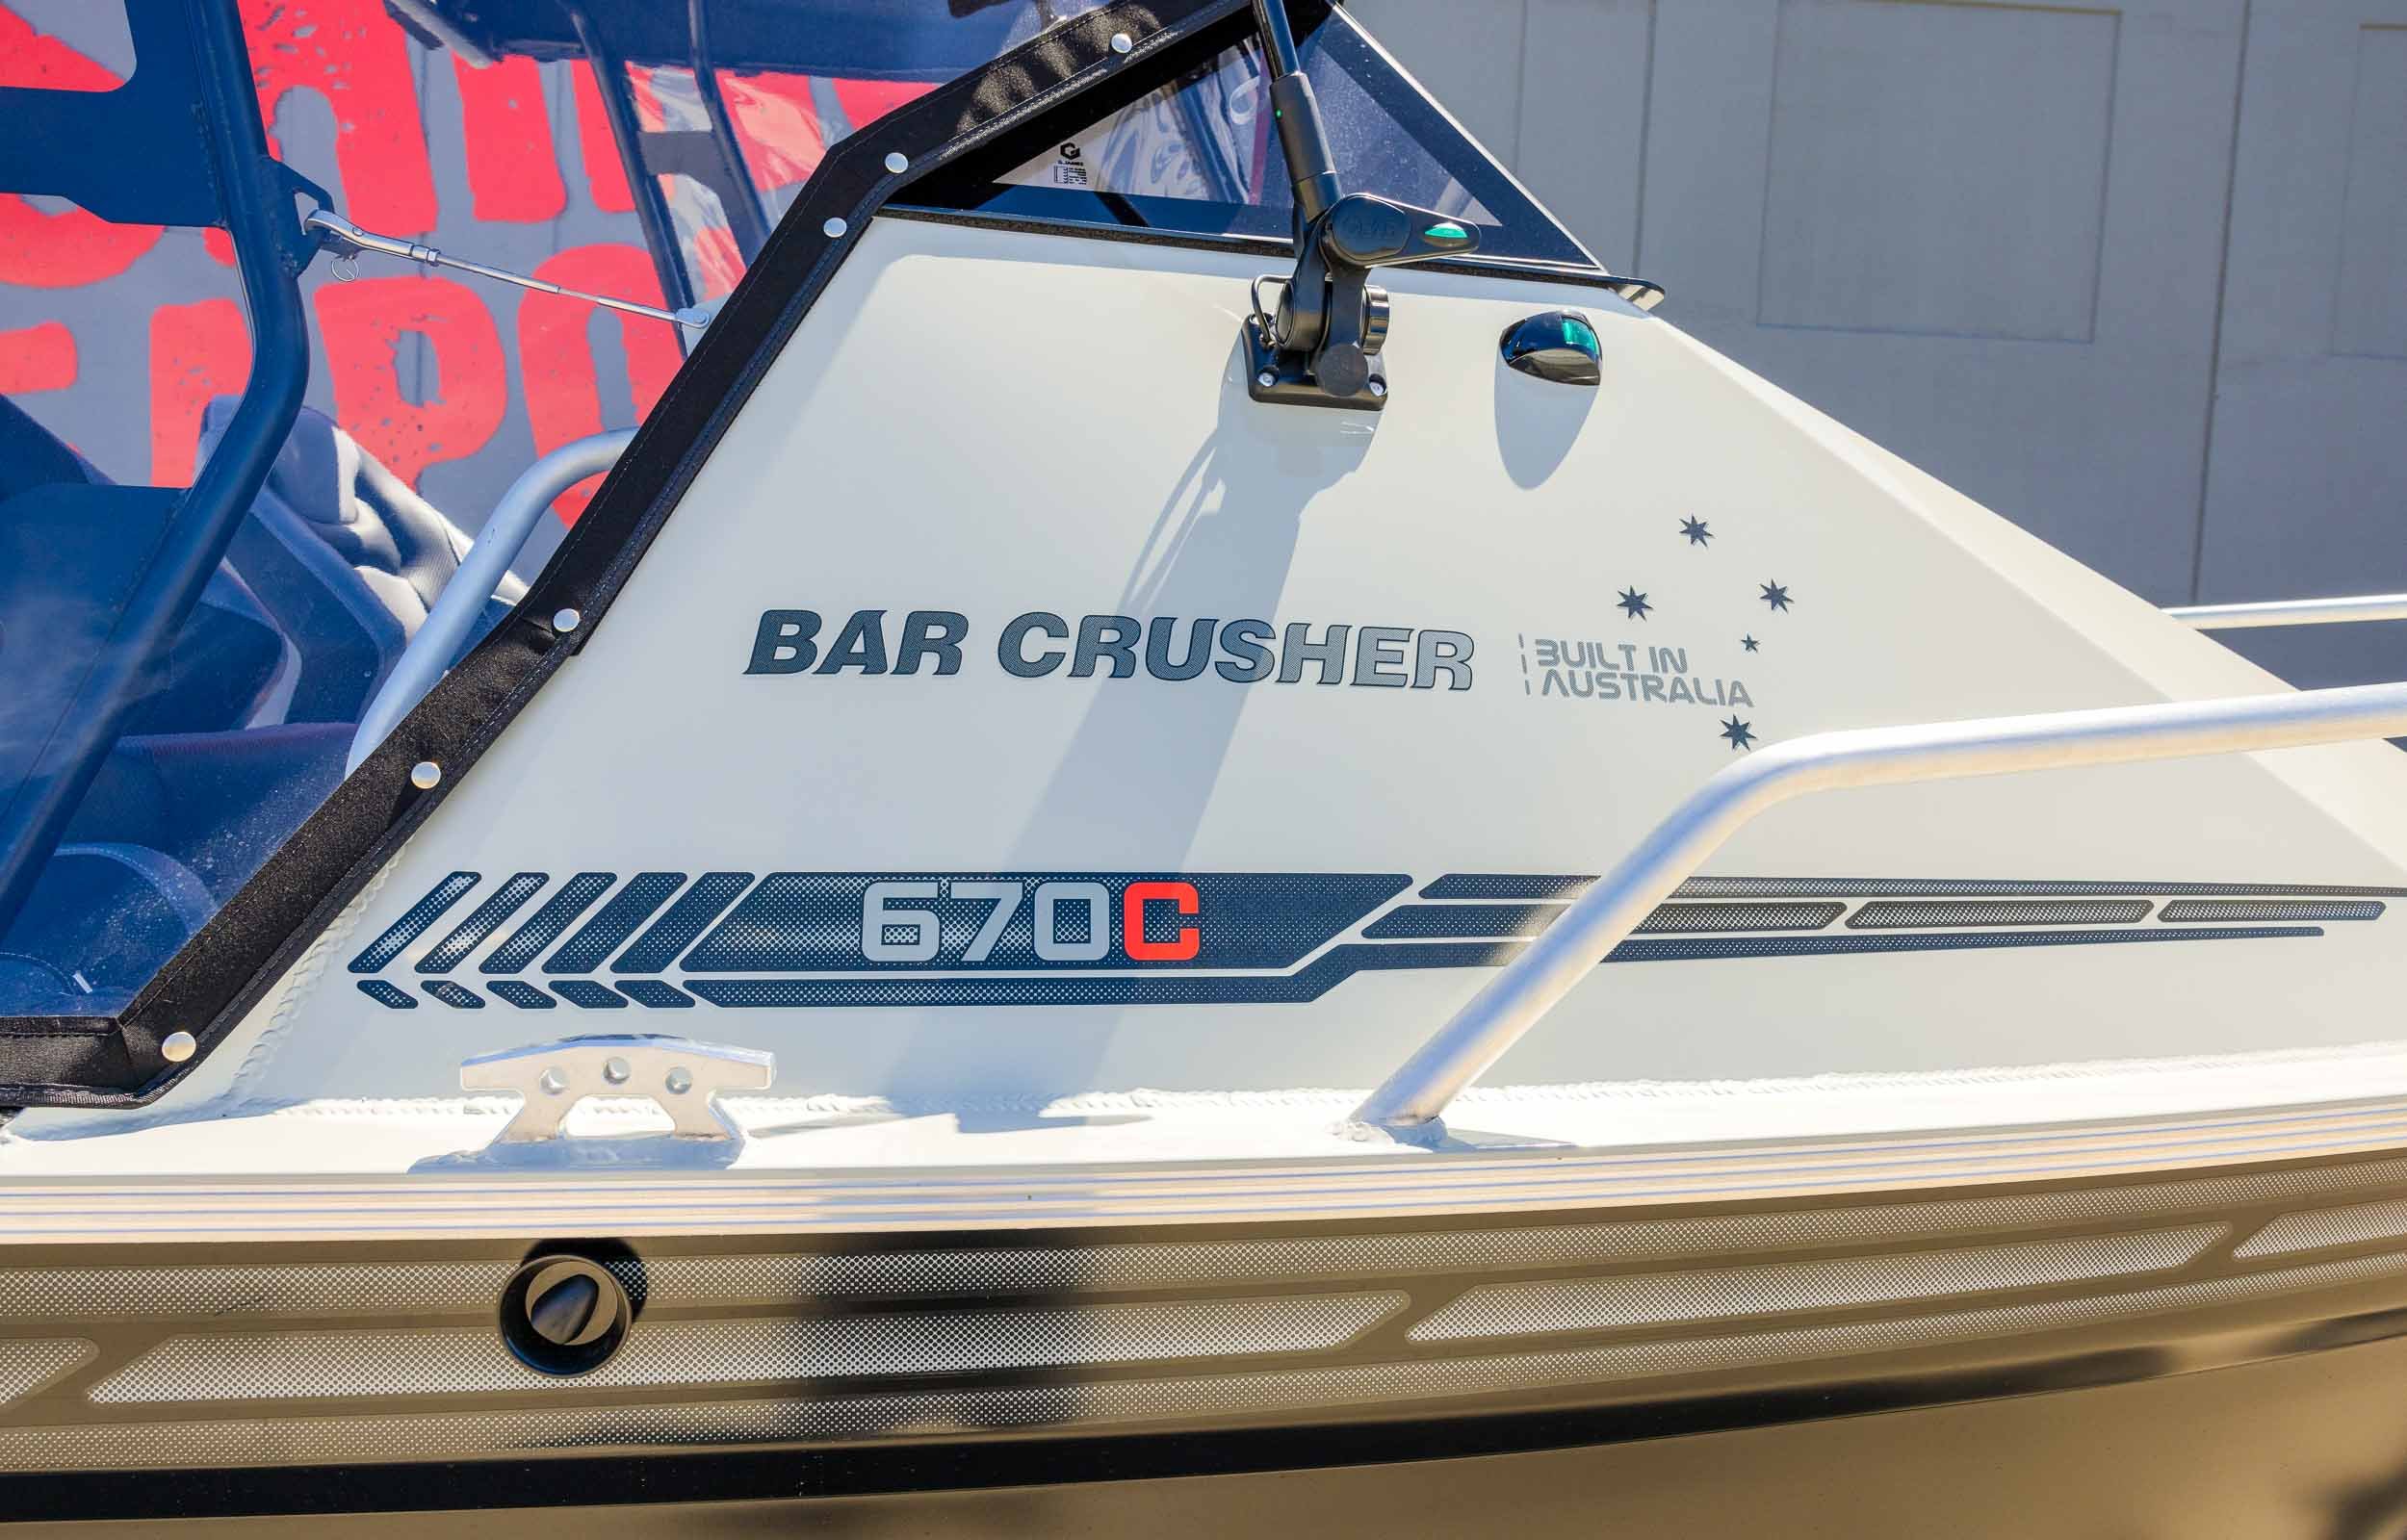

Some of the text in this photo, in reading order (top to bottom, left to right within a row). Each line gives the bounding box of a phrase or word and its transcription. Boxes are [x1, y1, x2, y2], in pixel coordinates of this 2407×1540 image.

[742, 609, 1474, 691] BAR CRUSHER
[1535, 638, 1688, 674] BUILT IN
[1541, 668, 1754, 707] AUSTRALIA
[862, 881, 1200, 962] 670C
